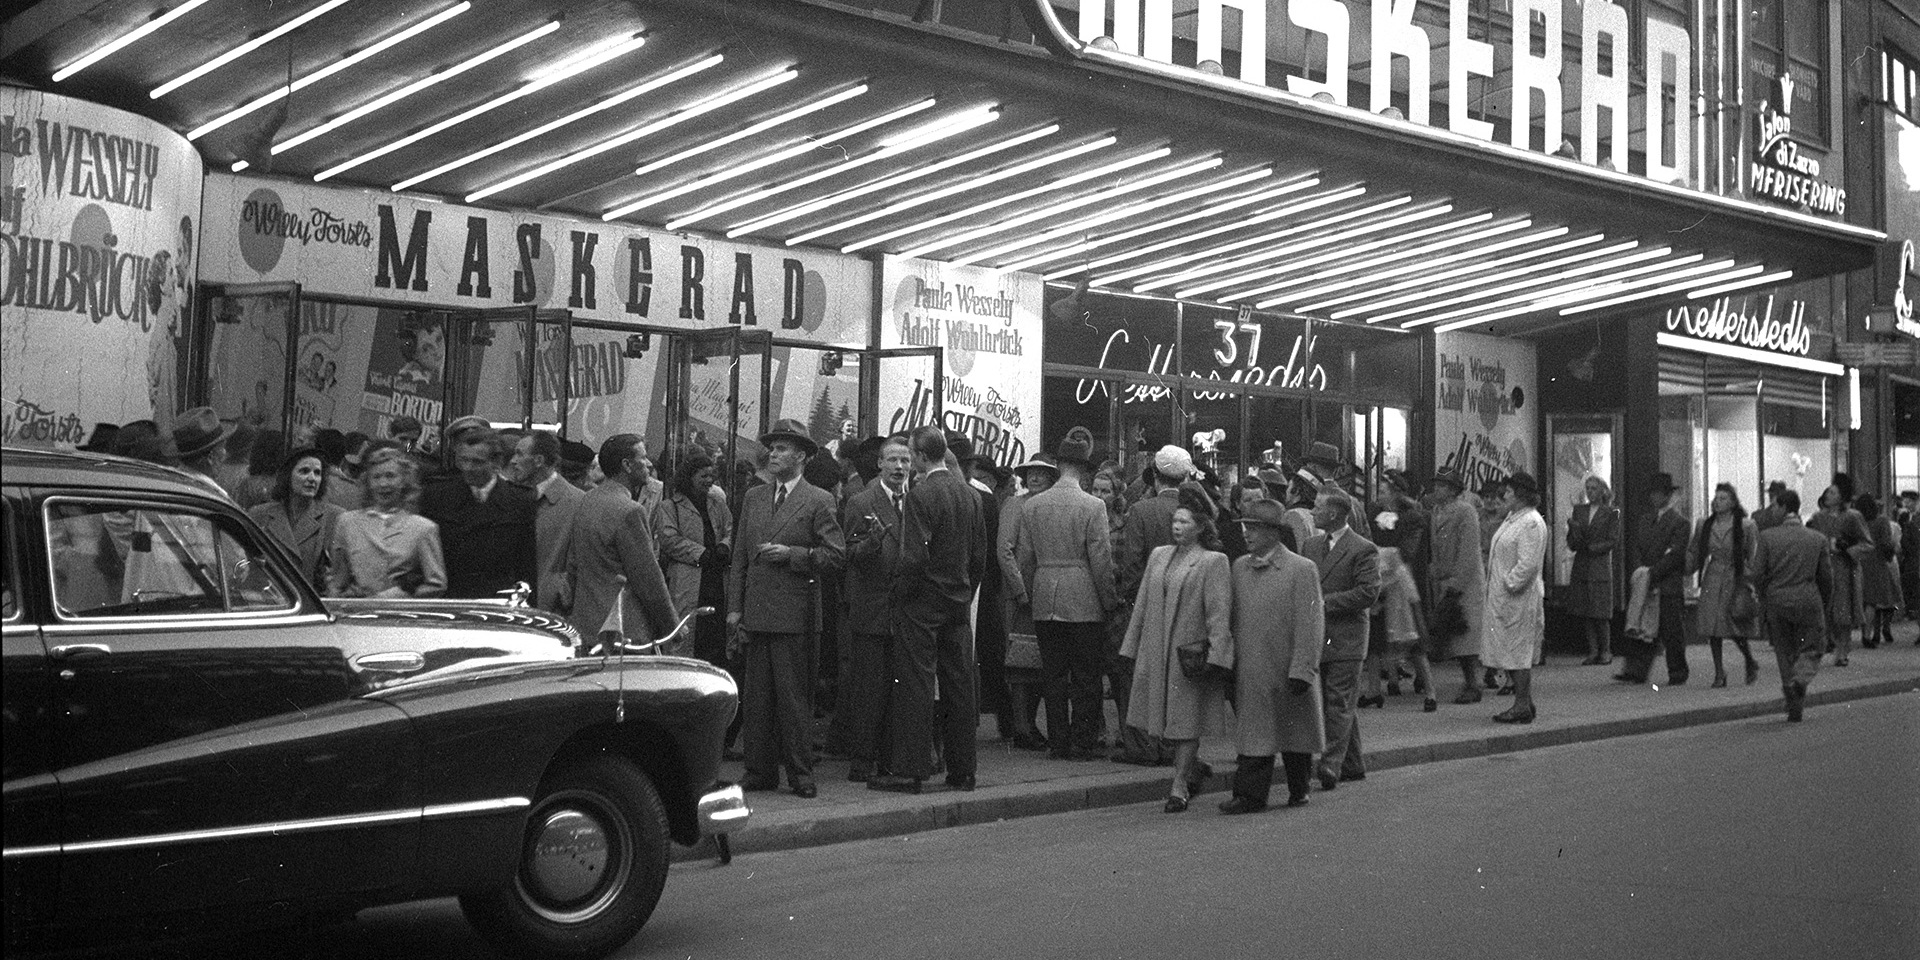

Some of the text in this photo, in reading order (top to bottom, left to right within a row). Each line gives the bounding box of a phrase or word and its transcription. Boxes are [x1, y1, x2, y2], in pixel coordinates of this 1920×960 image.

[1078, 0, 1691, 188] SKERAD
[35, 118, 159, 211] WESSELY
[243, 200, 312, 247] Willy
[311, 207, 373, 248] Forsts
[374, 204, 805, 332] MASKERAD
[914, 277, 1015, 327] Paula Wessely
[515, 339, 625, 405] MASERAD
[900, 312, 1023, 356] Adolf Wohlbrück
[1214, 319, 1261, 367] 37
[888, 378, 1026, 468] MSERAD
